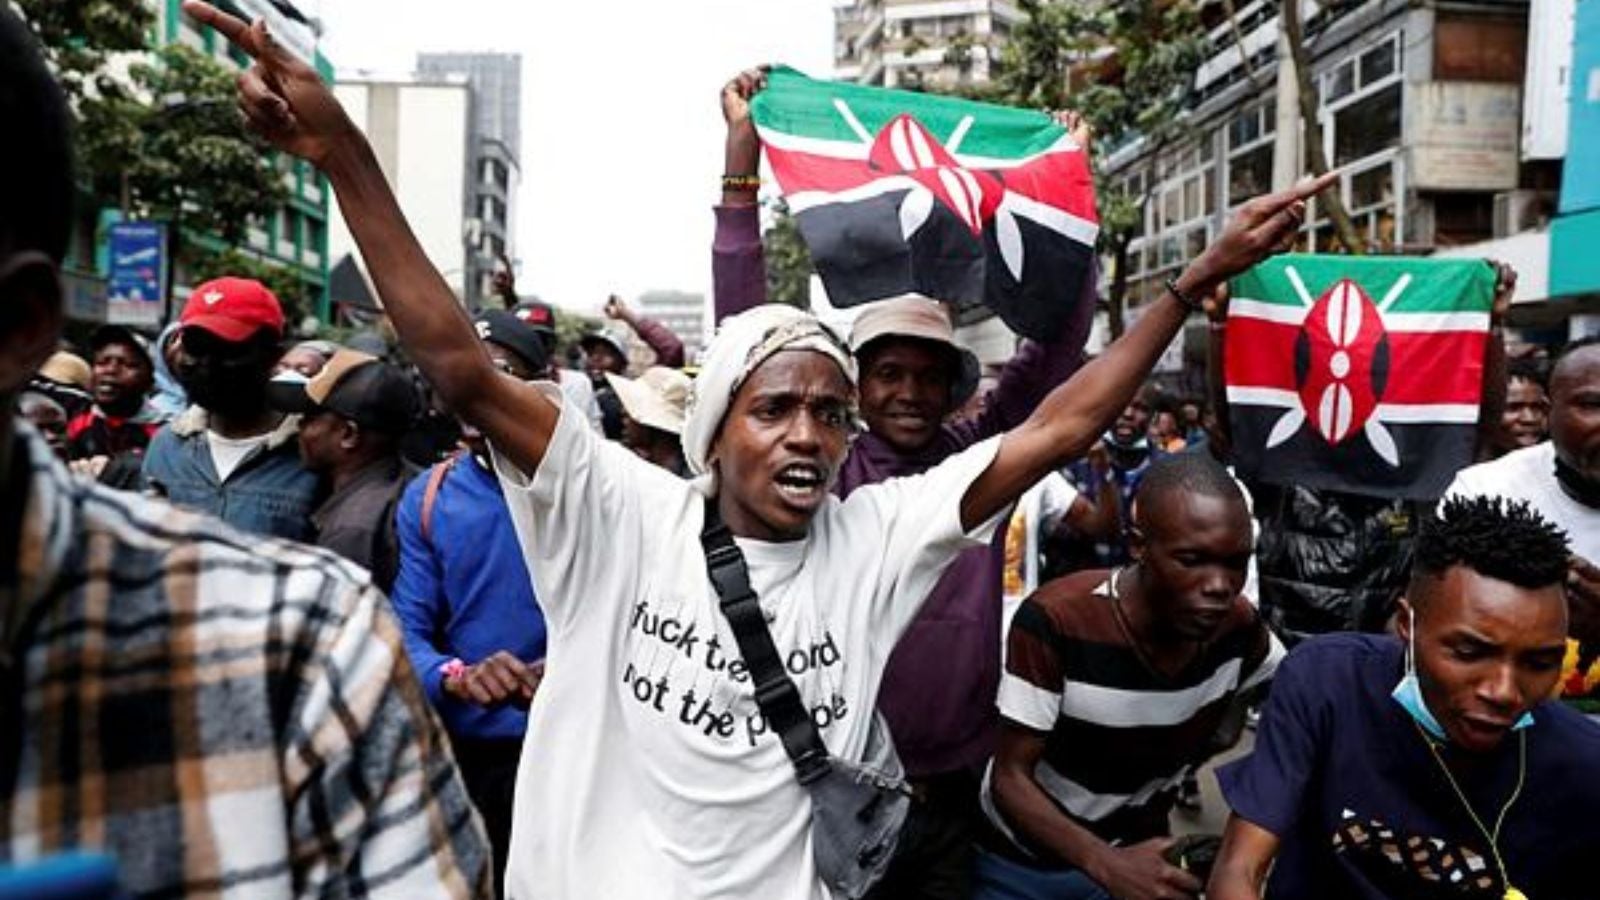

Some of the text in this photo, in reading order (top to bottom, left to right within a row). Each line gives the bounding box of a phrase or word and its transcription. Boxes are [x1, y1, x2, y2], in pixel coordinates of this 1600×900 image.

[631, 600, 700, 659] fuck
[785, 631, 842, 674] ord
[679, 688, 735, 737] the
